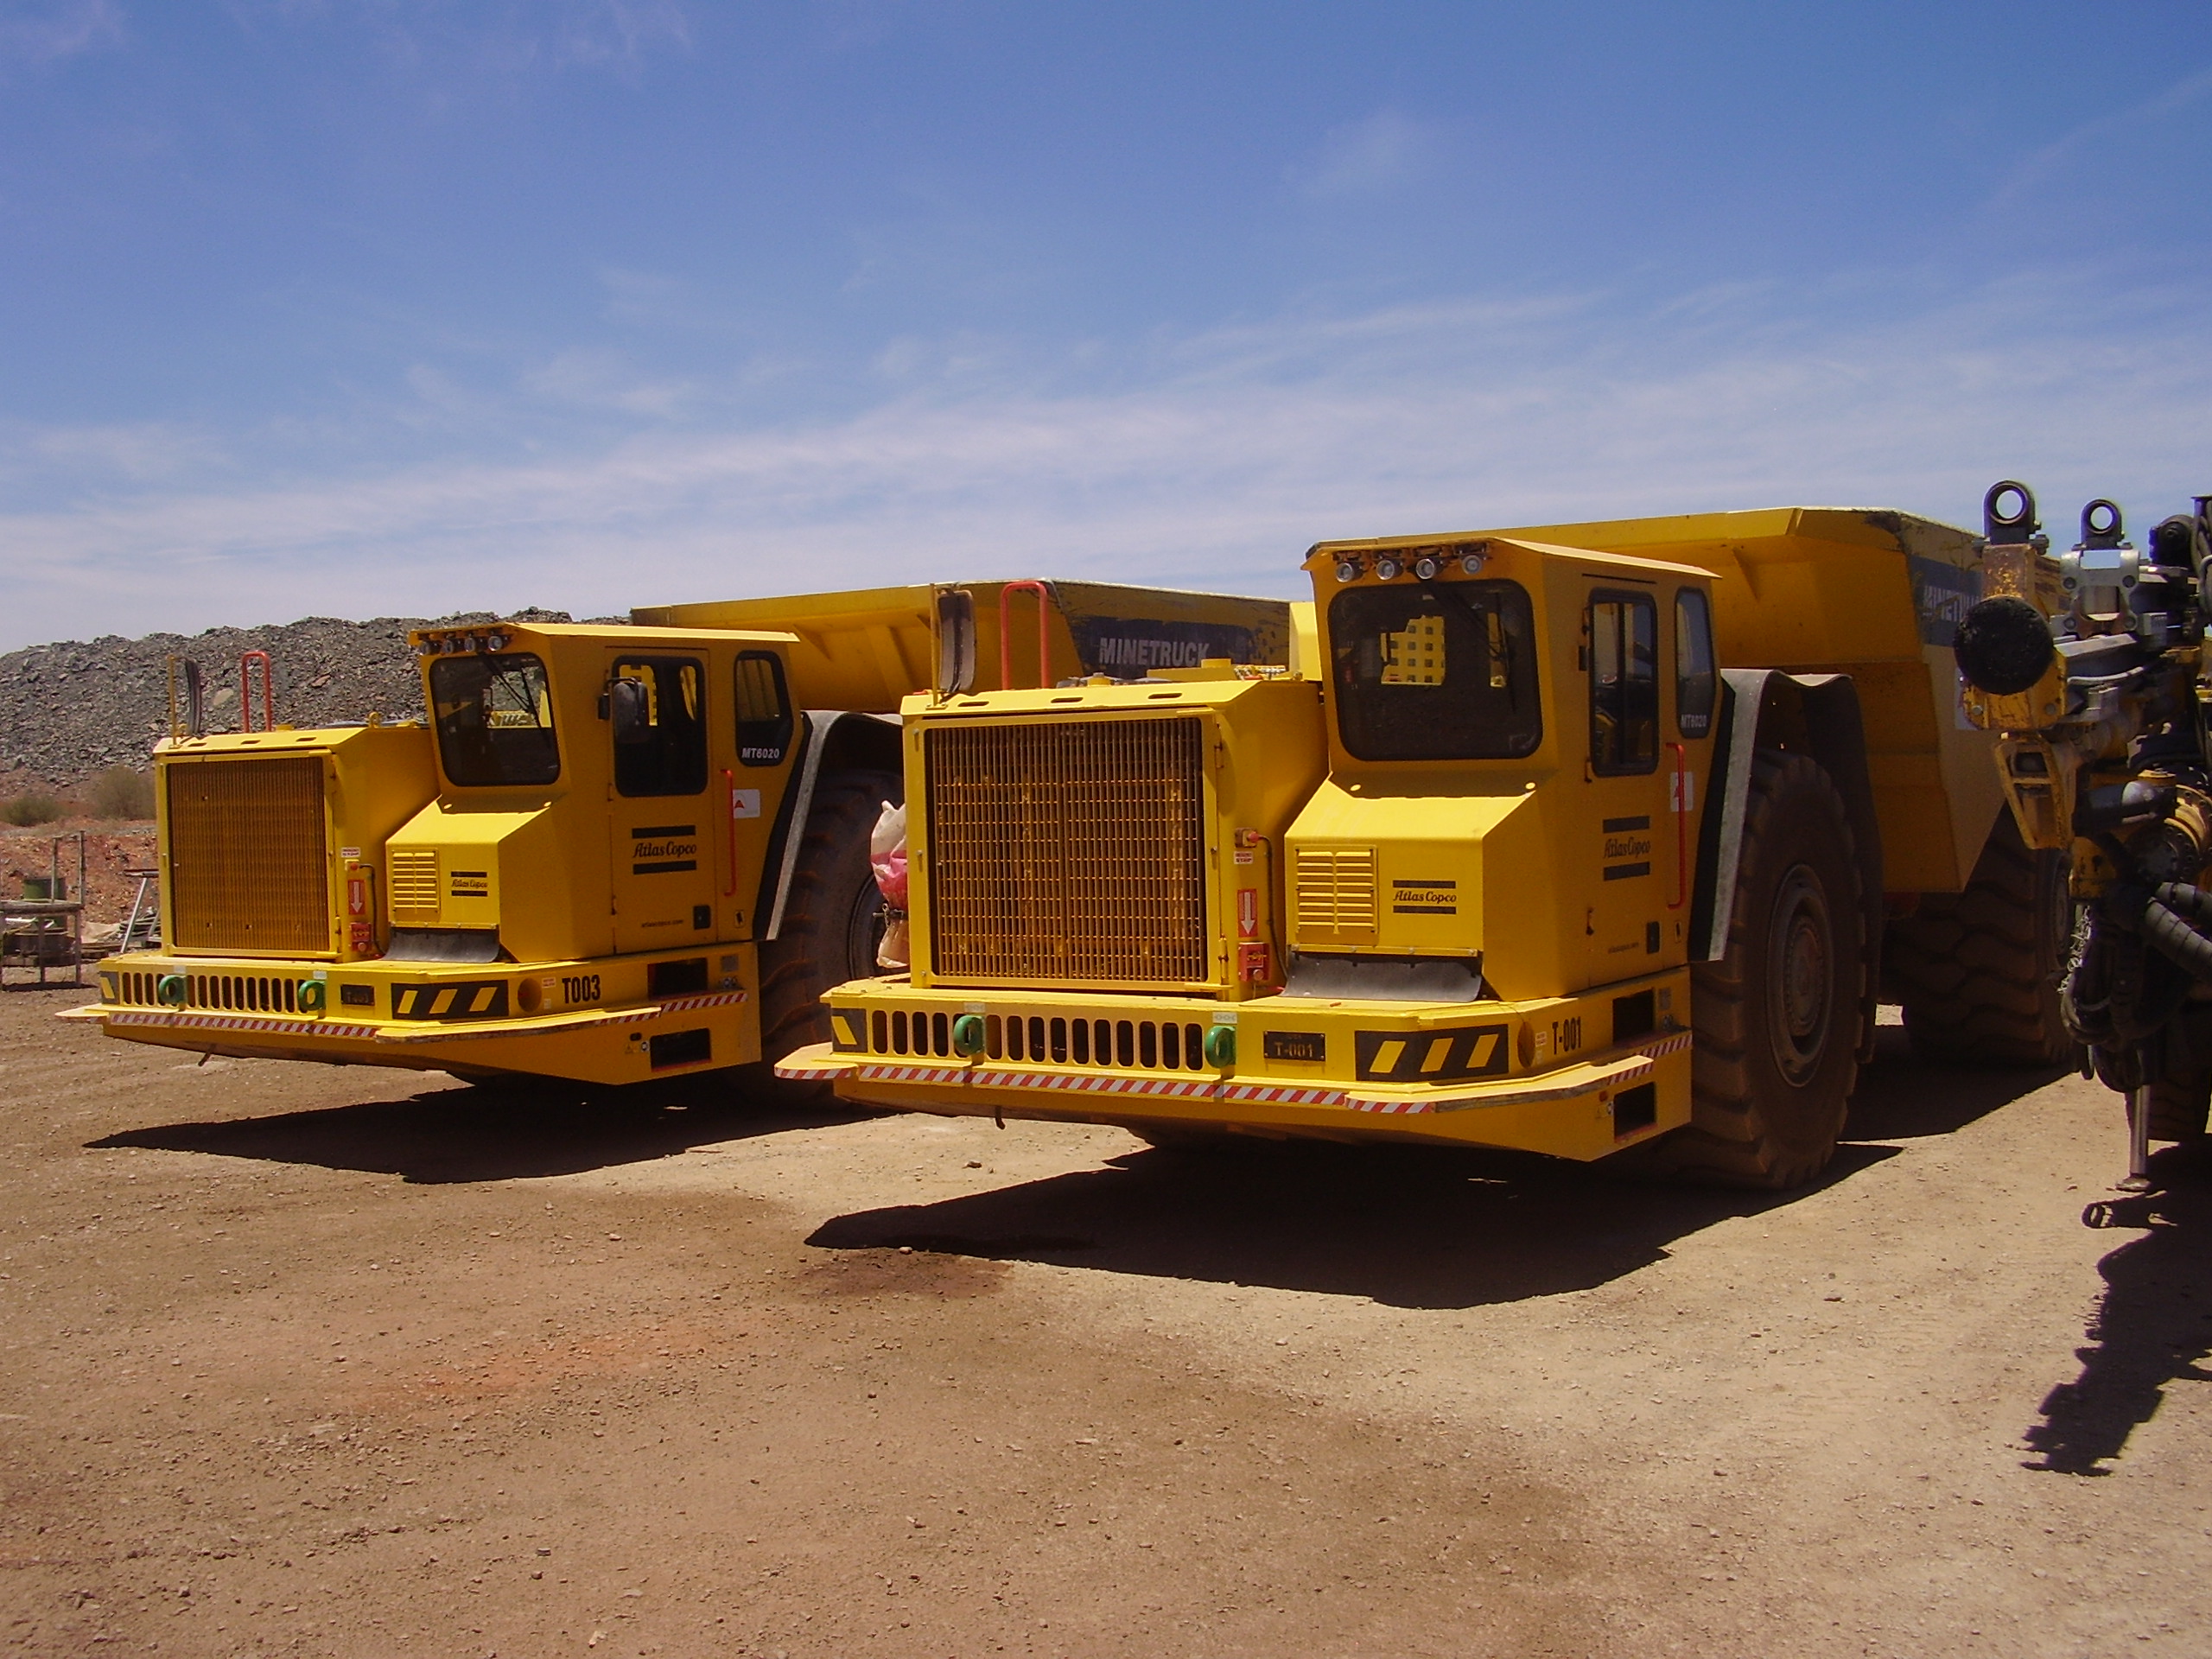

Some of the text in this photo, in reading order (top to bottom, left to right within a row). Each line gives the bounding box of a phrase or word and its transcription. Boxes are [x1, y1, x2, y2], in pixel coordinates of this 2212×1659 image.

[1099, 638, 1210, 666] MINETRUCK
[741, 747, 780, 760] MT6020
[632, 842, 696, 858] Atlas Copco
[1393, 890, 1457, 904] Atlas Copco
[562, 974, 601, 1004] T003
[1552, 1016, 1581, 1055] T-001
[1274, 1041, 1313, 1058] T-001
